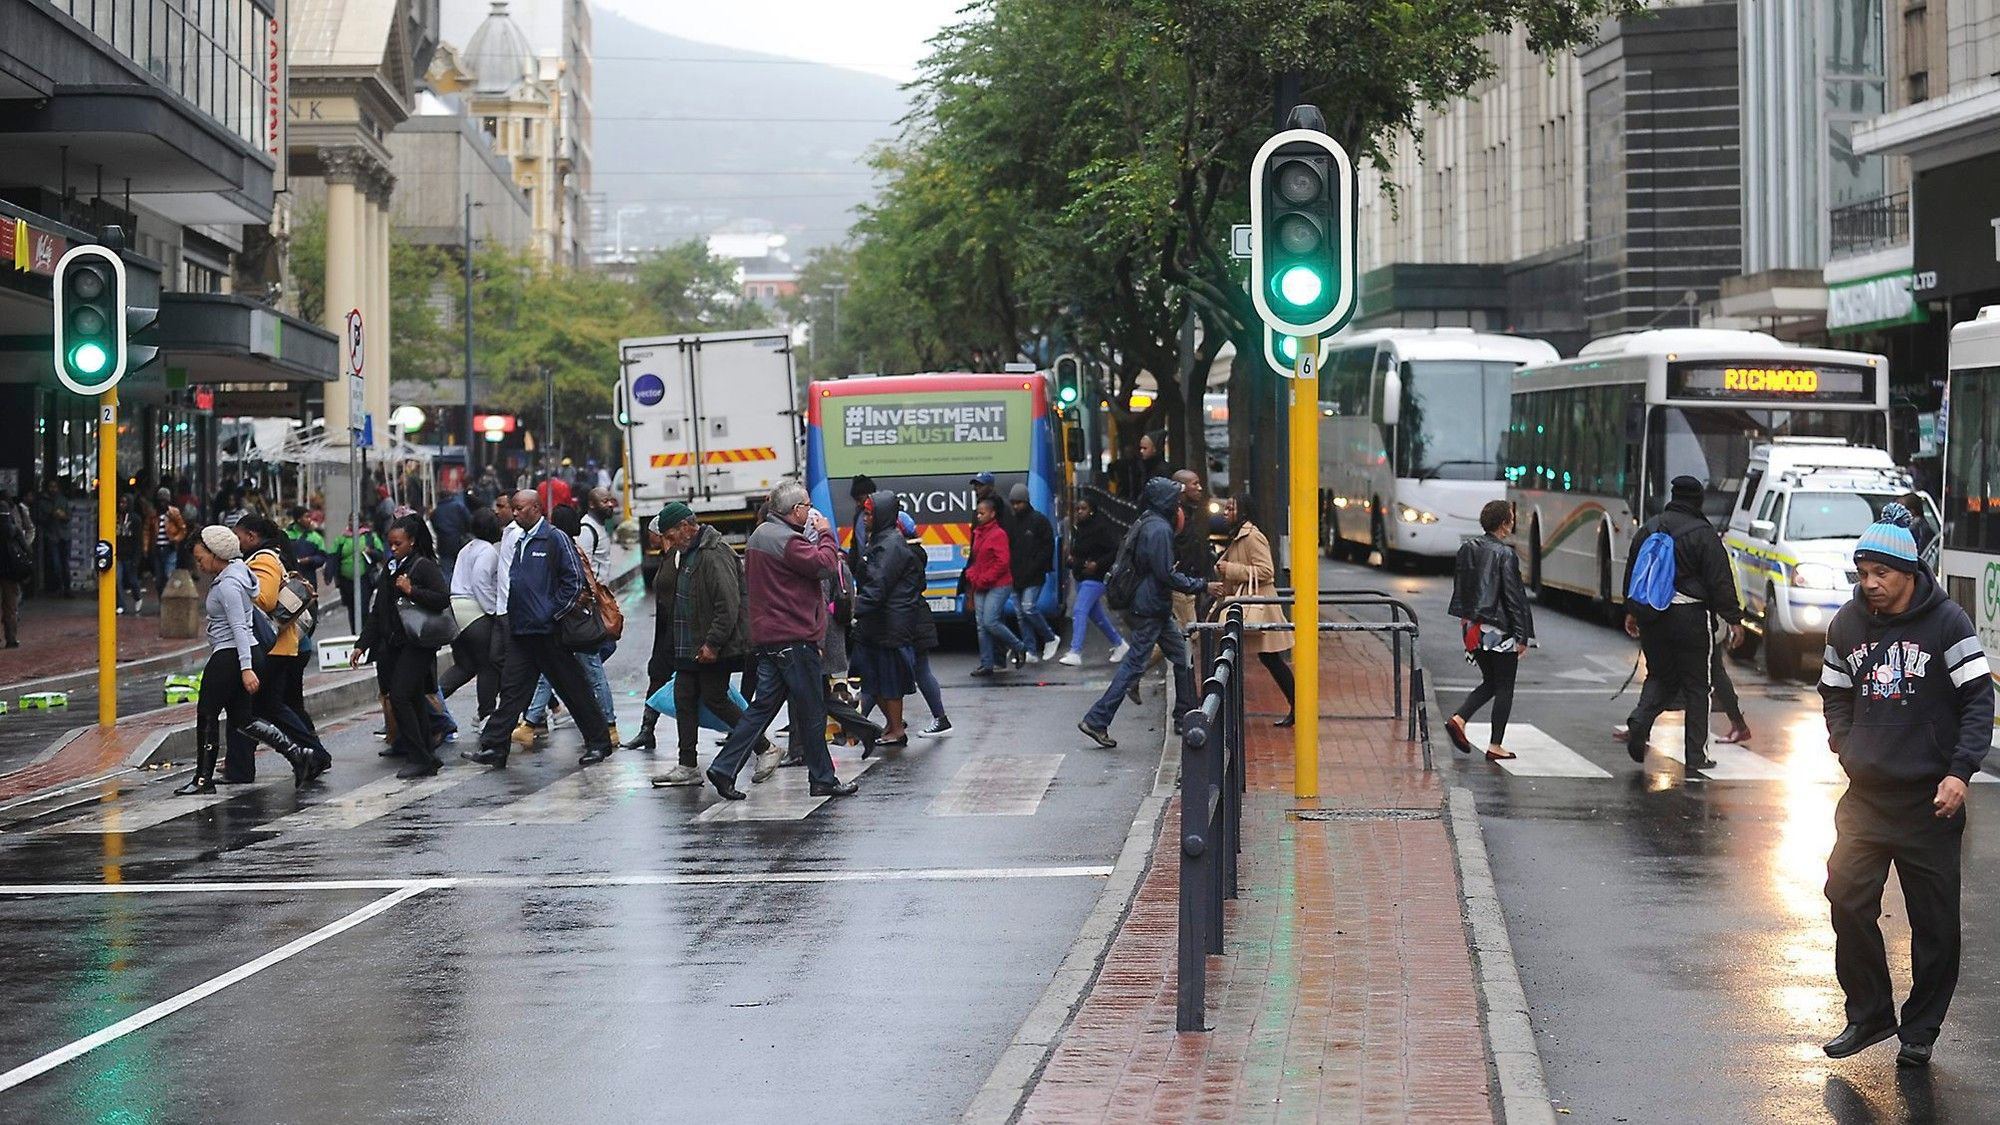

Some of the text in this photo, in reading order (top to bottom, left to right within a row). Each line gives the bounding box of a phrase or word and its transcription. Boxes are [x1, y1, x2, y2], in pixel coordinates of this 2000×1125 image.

[1913, 270, 1937, 291] LTD
[1303, 357, 1311, 375] 6
[1723, 367, 1819, 393] RICHWOOD
[635, 388, 662, 399] vector
[104, 408, 111, 421] 2
[845, 405, 1005, 427] #INVESTMENT
